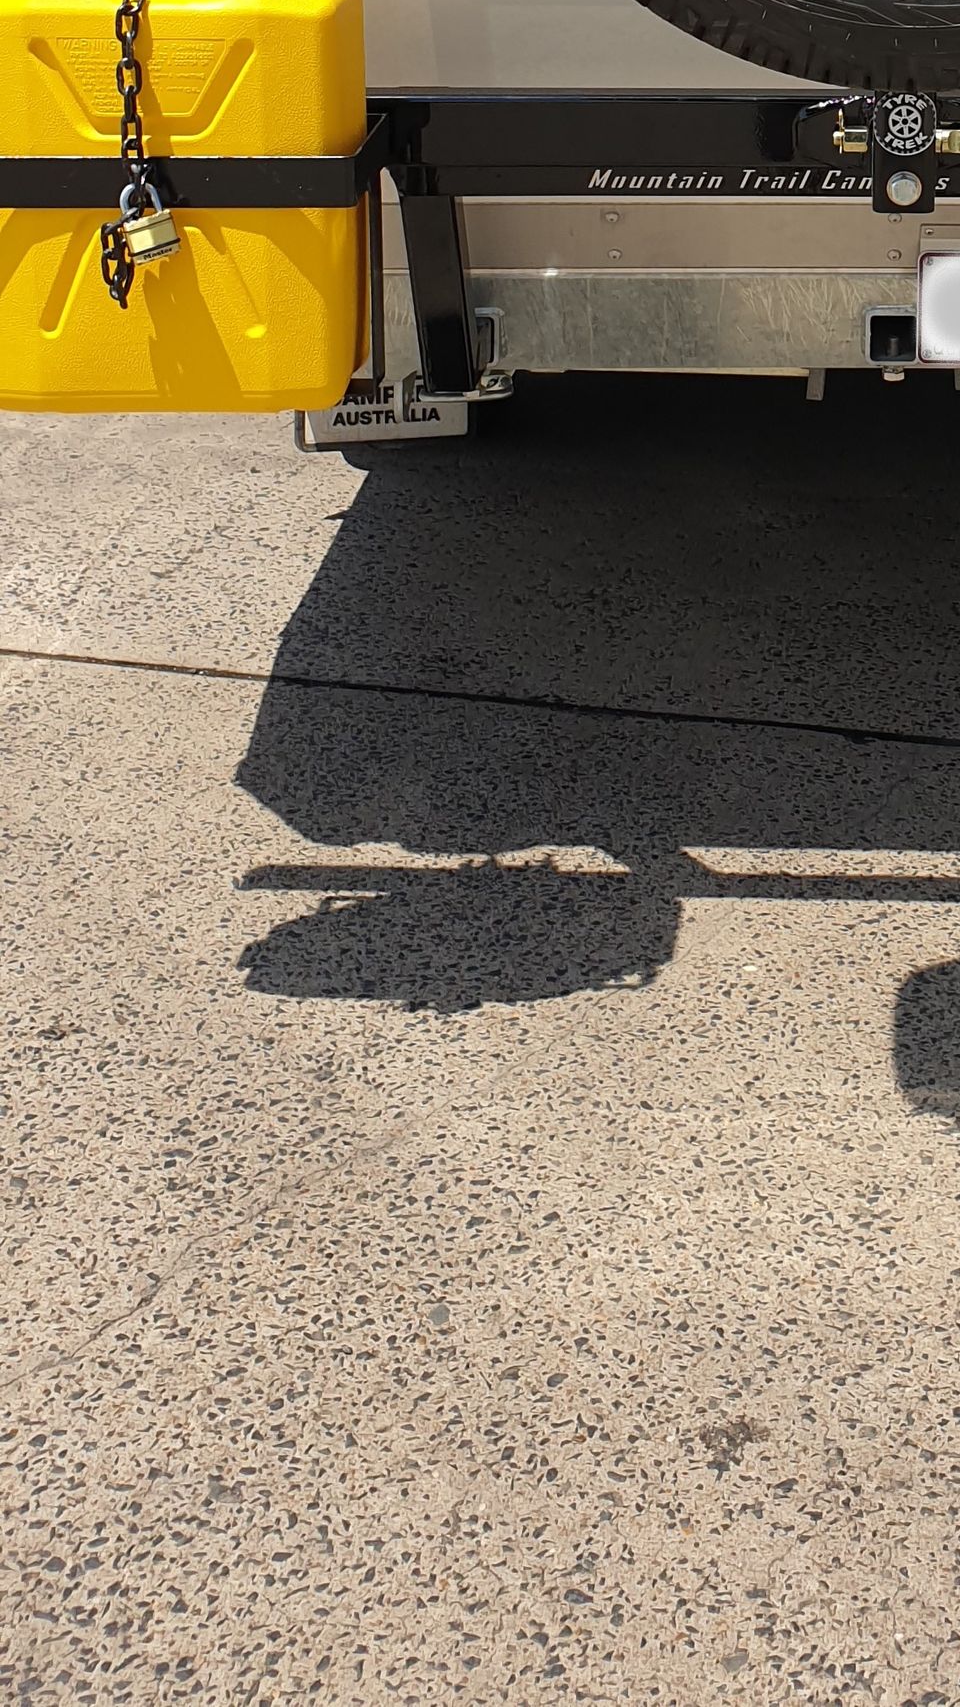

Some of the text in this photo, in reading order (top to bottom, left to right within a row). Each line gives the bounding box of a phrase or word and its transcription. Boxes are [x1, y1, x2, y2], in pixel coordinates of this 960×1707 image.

[882, 94, 928, 110] TYRE
[884, 132, 928, 149] TREK
[587, 169, 724, 189] Mountain
[739, 169, 811, 190] Trail
[332, 407, 440, 426] AUSTRLIA
